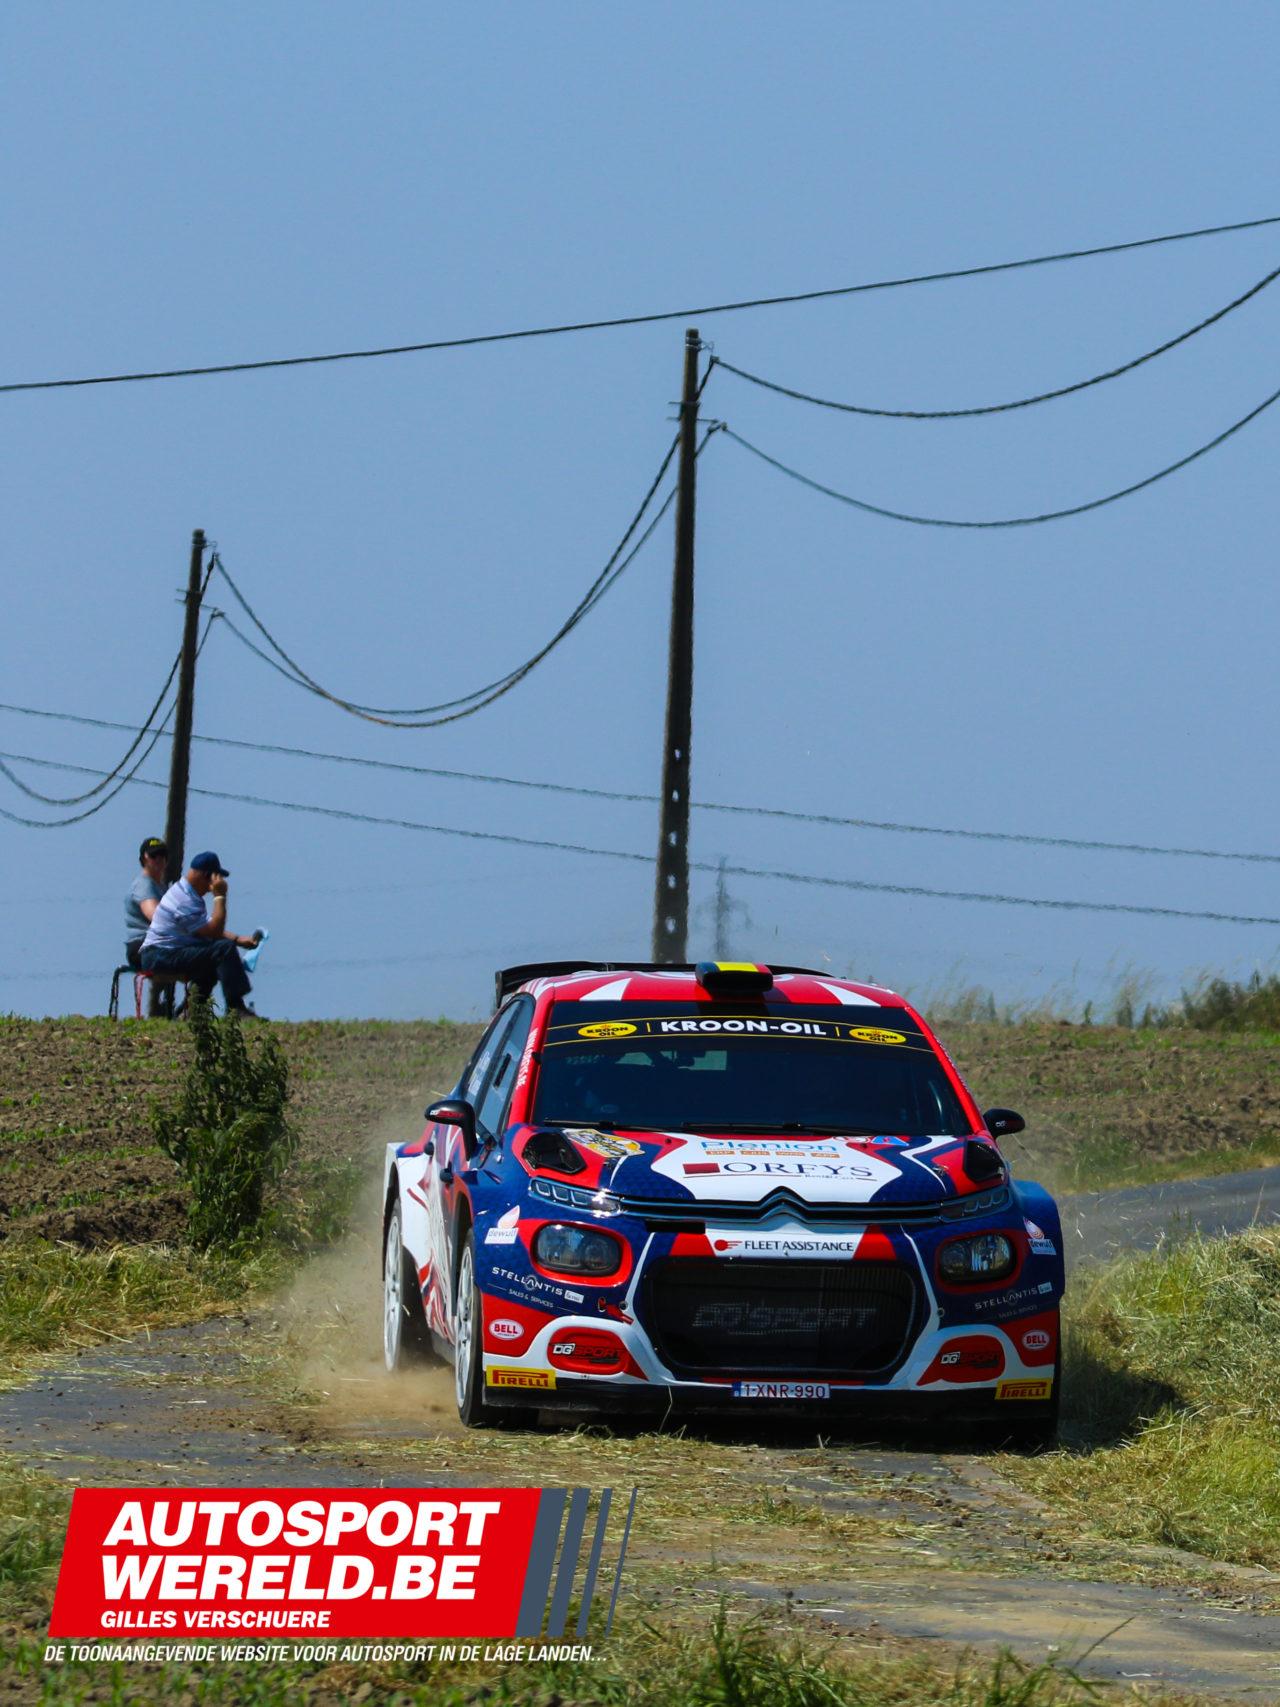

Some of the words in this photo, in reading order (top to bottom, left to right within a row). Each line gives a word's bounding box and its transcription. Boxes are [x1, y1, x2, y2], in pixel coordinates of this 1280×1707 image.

[660, 1020, 827, 1036] KROON-OIL
[723, 1162, 873, 1177] ORFYS
[744, 1240, 781, 1250] FLEET
[782, 1240, 855, 1252] ASSISTANCE
[491, 1266, 563, 1296] STELLANTIS
[974, 1287, 1038, 1310] STELLANTIS
[494, 1323, 518, 1334] BELL
[1026, 1335, 1047, 1344] BELL
[493, 1369, 549, 1387] PIRELLI
[745, 1384, 826, 1398] 1-XNR-990
[1001, 1382, 1048, 1398] PIRELLI
